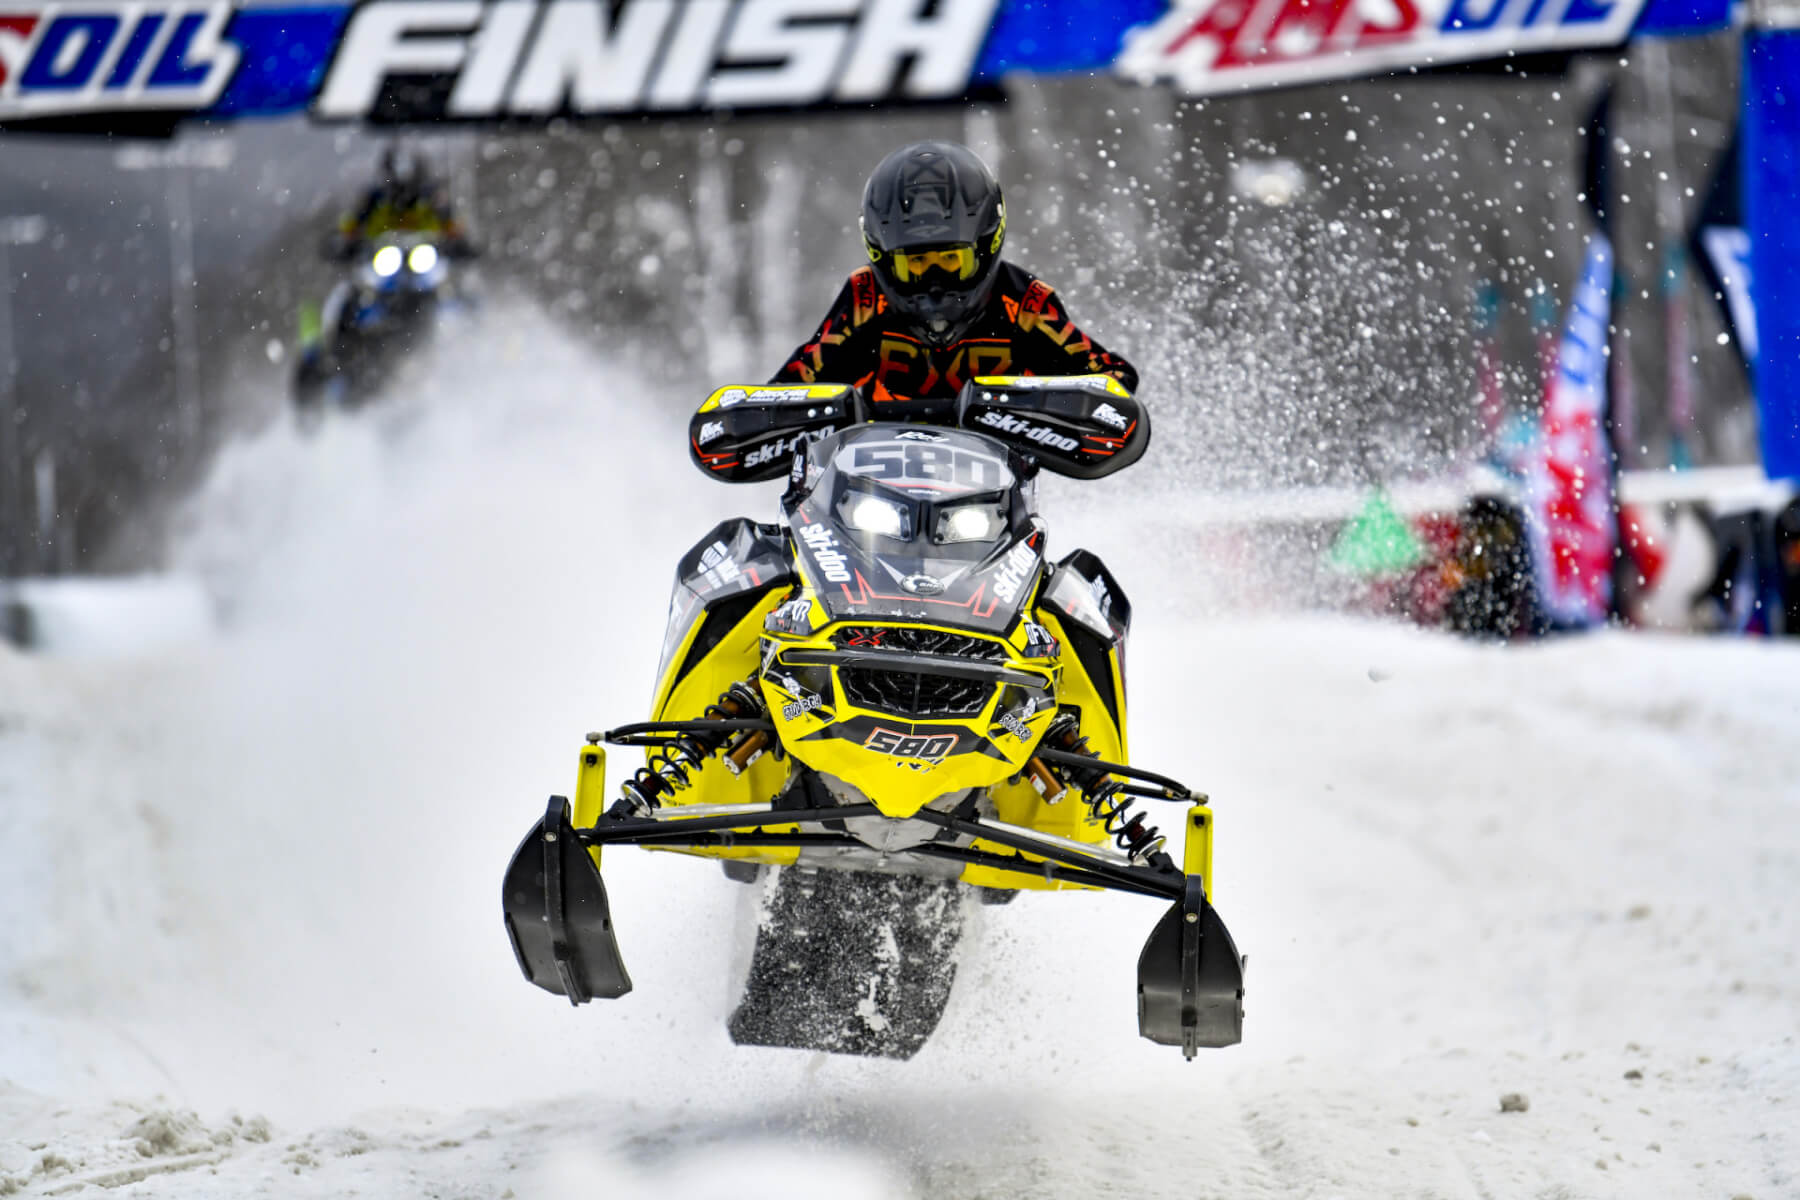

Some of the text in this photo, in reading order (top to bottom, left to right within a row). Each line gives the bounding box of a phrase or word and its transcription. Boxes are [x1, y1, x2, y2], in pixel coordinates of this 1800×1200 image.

[316, 0, 1000, 118] FINISH
[980, 411, 1080, 451] ski-doo
[854, 444, 1001, 488] 580
[799, 523, 852, 583] ski-doo
[865, 728, 958, 759] 580
